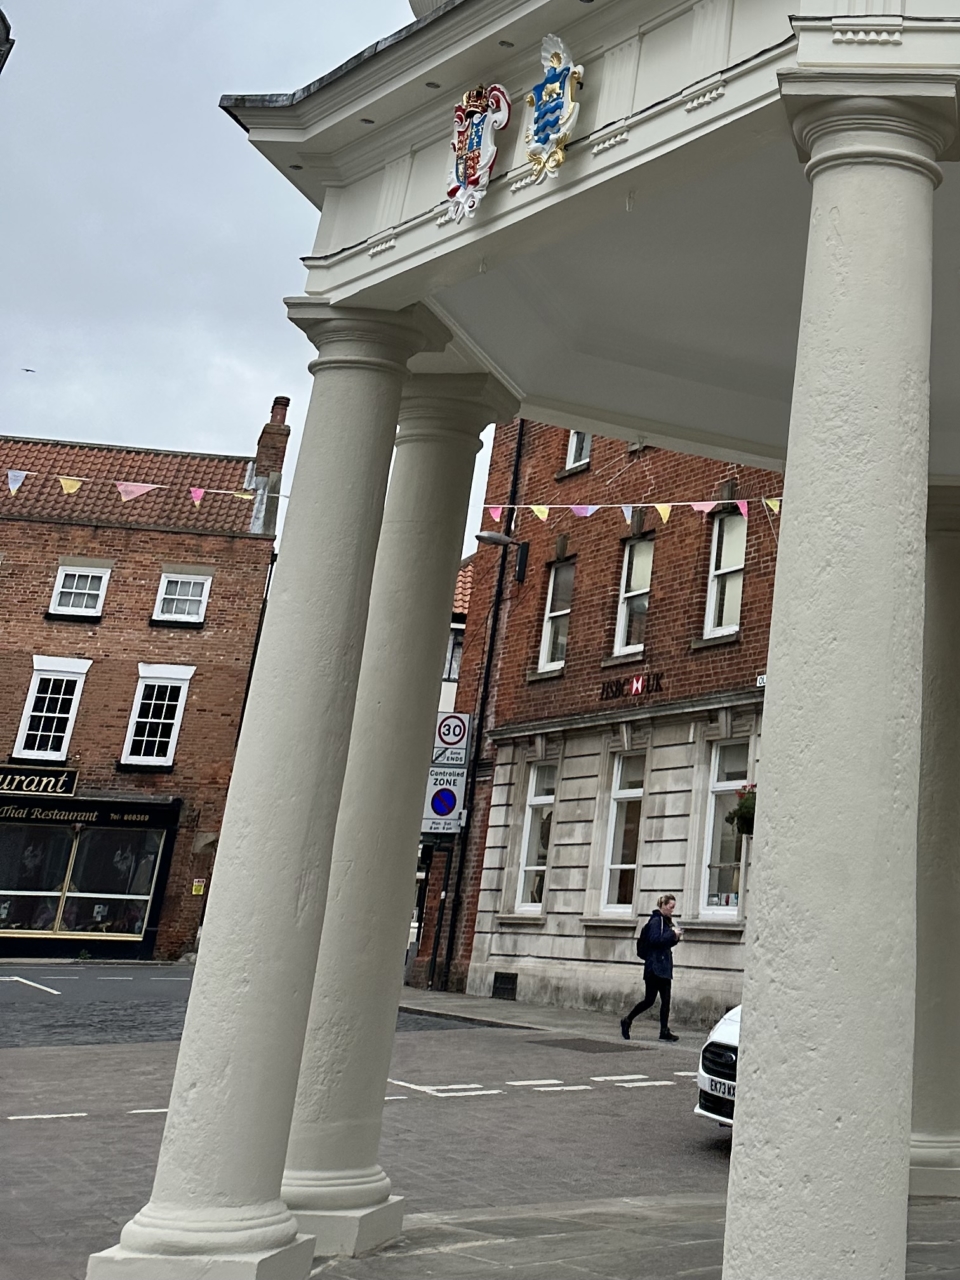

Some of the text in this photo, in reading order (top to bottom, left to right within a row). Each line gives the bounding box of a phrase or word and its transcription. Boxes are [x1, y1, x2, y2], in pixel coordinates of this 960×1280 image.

[600, 672, 664, 701] HSBC UK
[442, 723, 462, 737] 30
[430, 769, 465, 778] Controlled
[433, 777, 458, 787] ZONE
[30, 807, 98, 821] Restaurant
